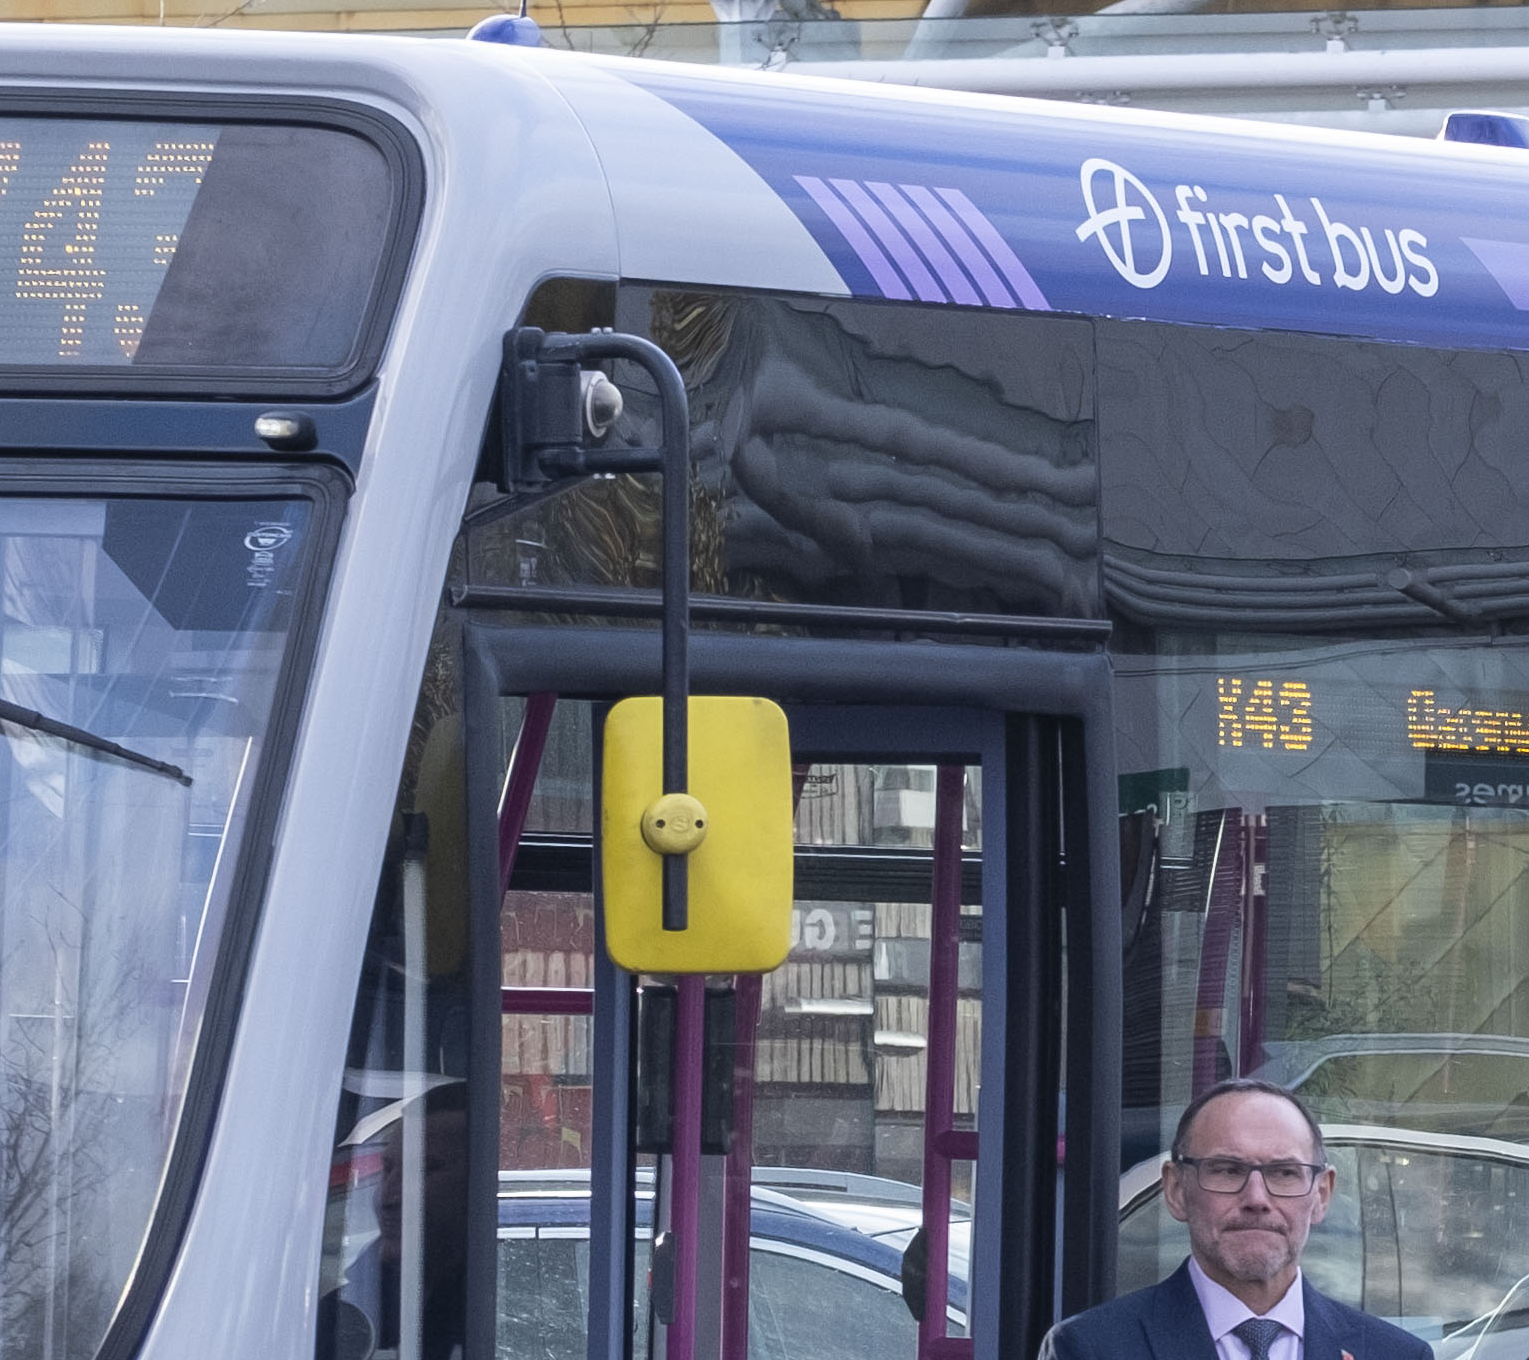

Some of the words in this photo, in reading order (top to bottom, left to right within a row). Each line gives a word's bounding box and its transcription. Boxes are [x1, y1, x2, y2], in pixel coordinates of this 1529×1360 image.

[1174, 184, 1322, 286] first
[1309, 196, 1440, 297] bus
[1216, 677, 1314, 751] X43
